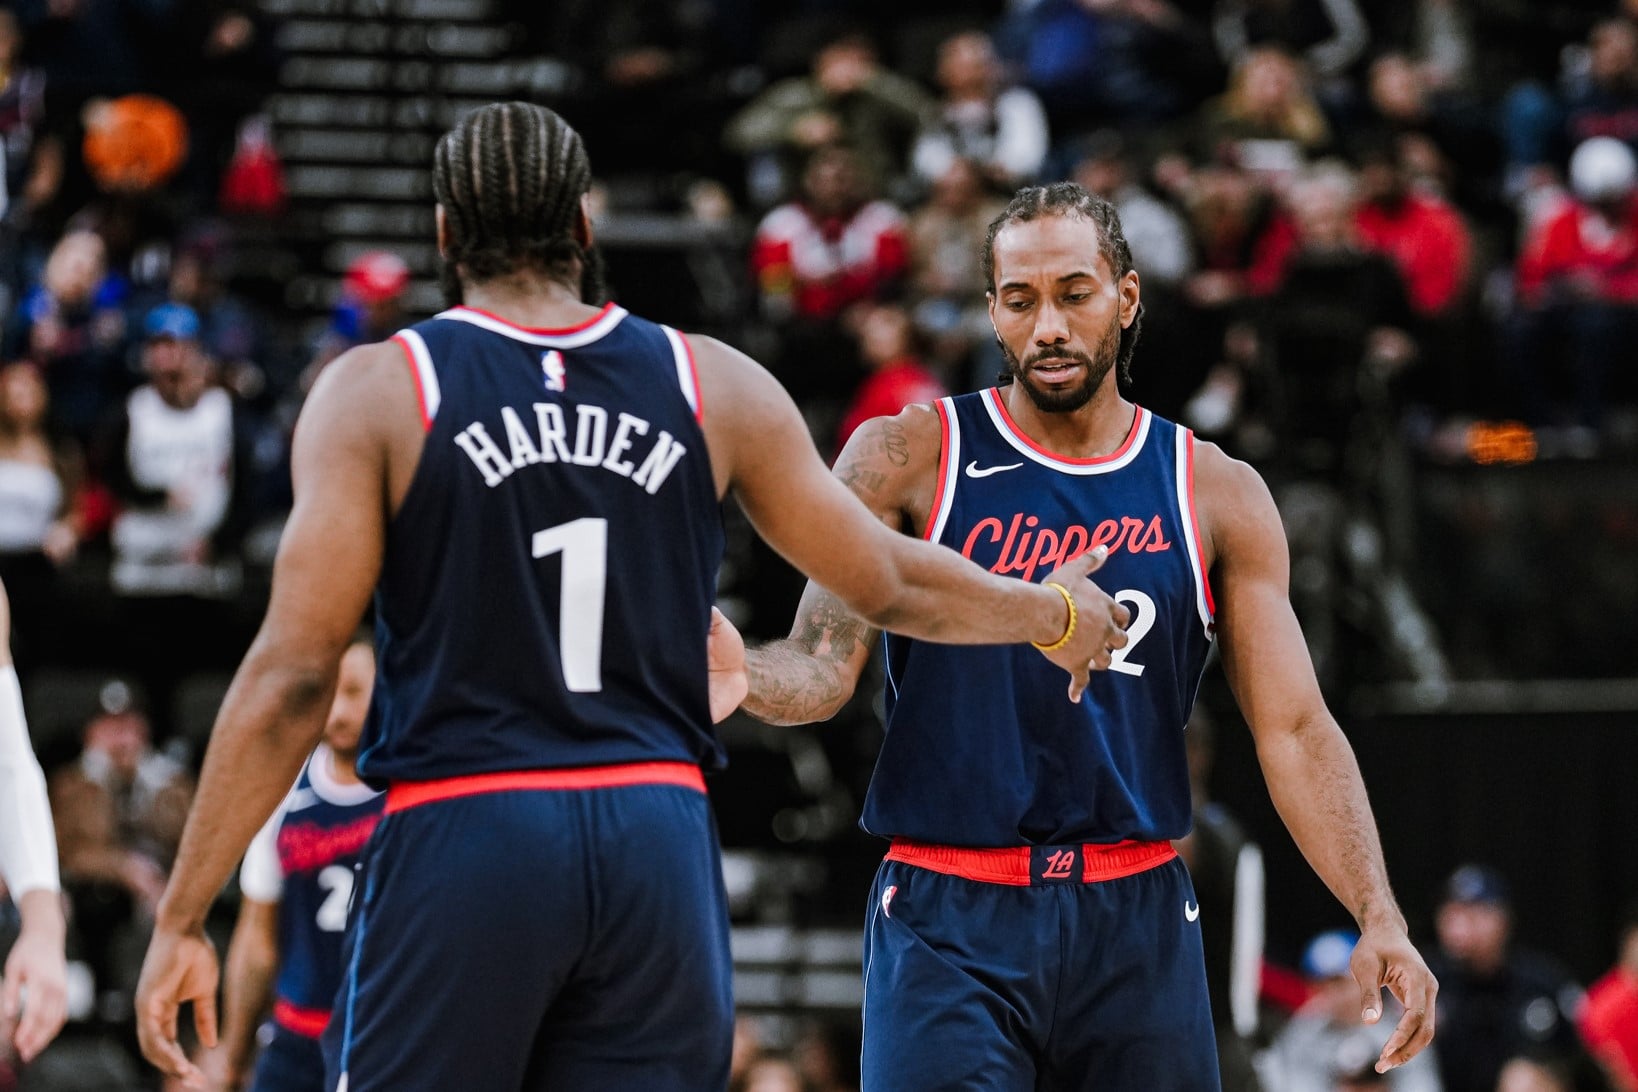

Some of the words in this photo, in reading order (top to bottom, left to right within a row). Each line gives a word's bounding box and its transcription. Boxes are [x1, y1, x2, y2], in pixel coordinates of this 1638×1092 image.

[454, 402, 686, 494] HARDEN
[961, 513, 1171, 582] Clippers
[532, 517, 607, 692] 1
[1108, 589, 1156, 677] 2
